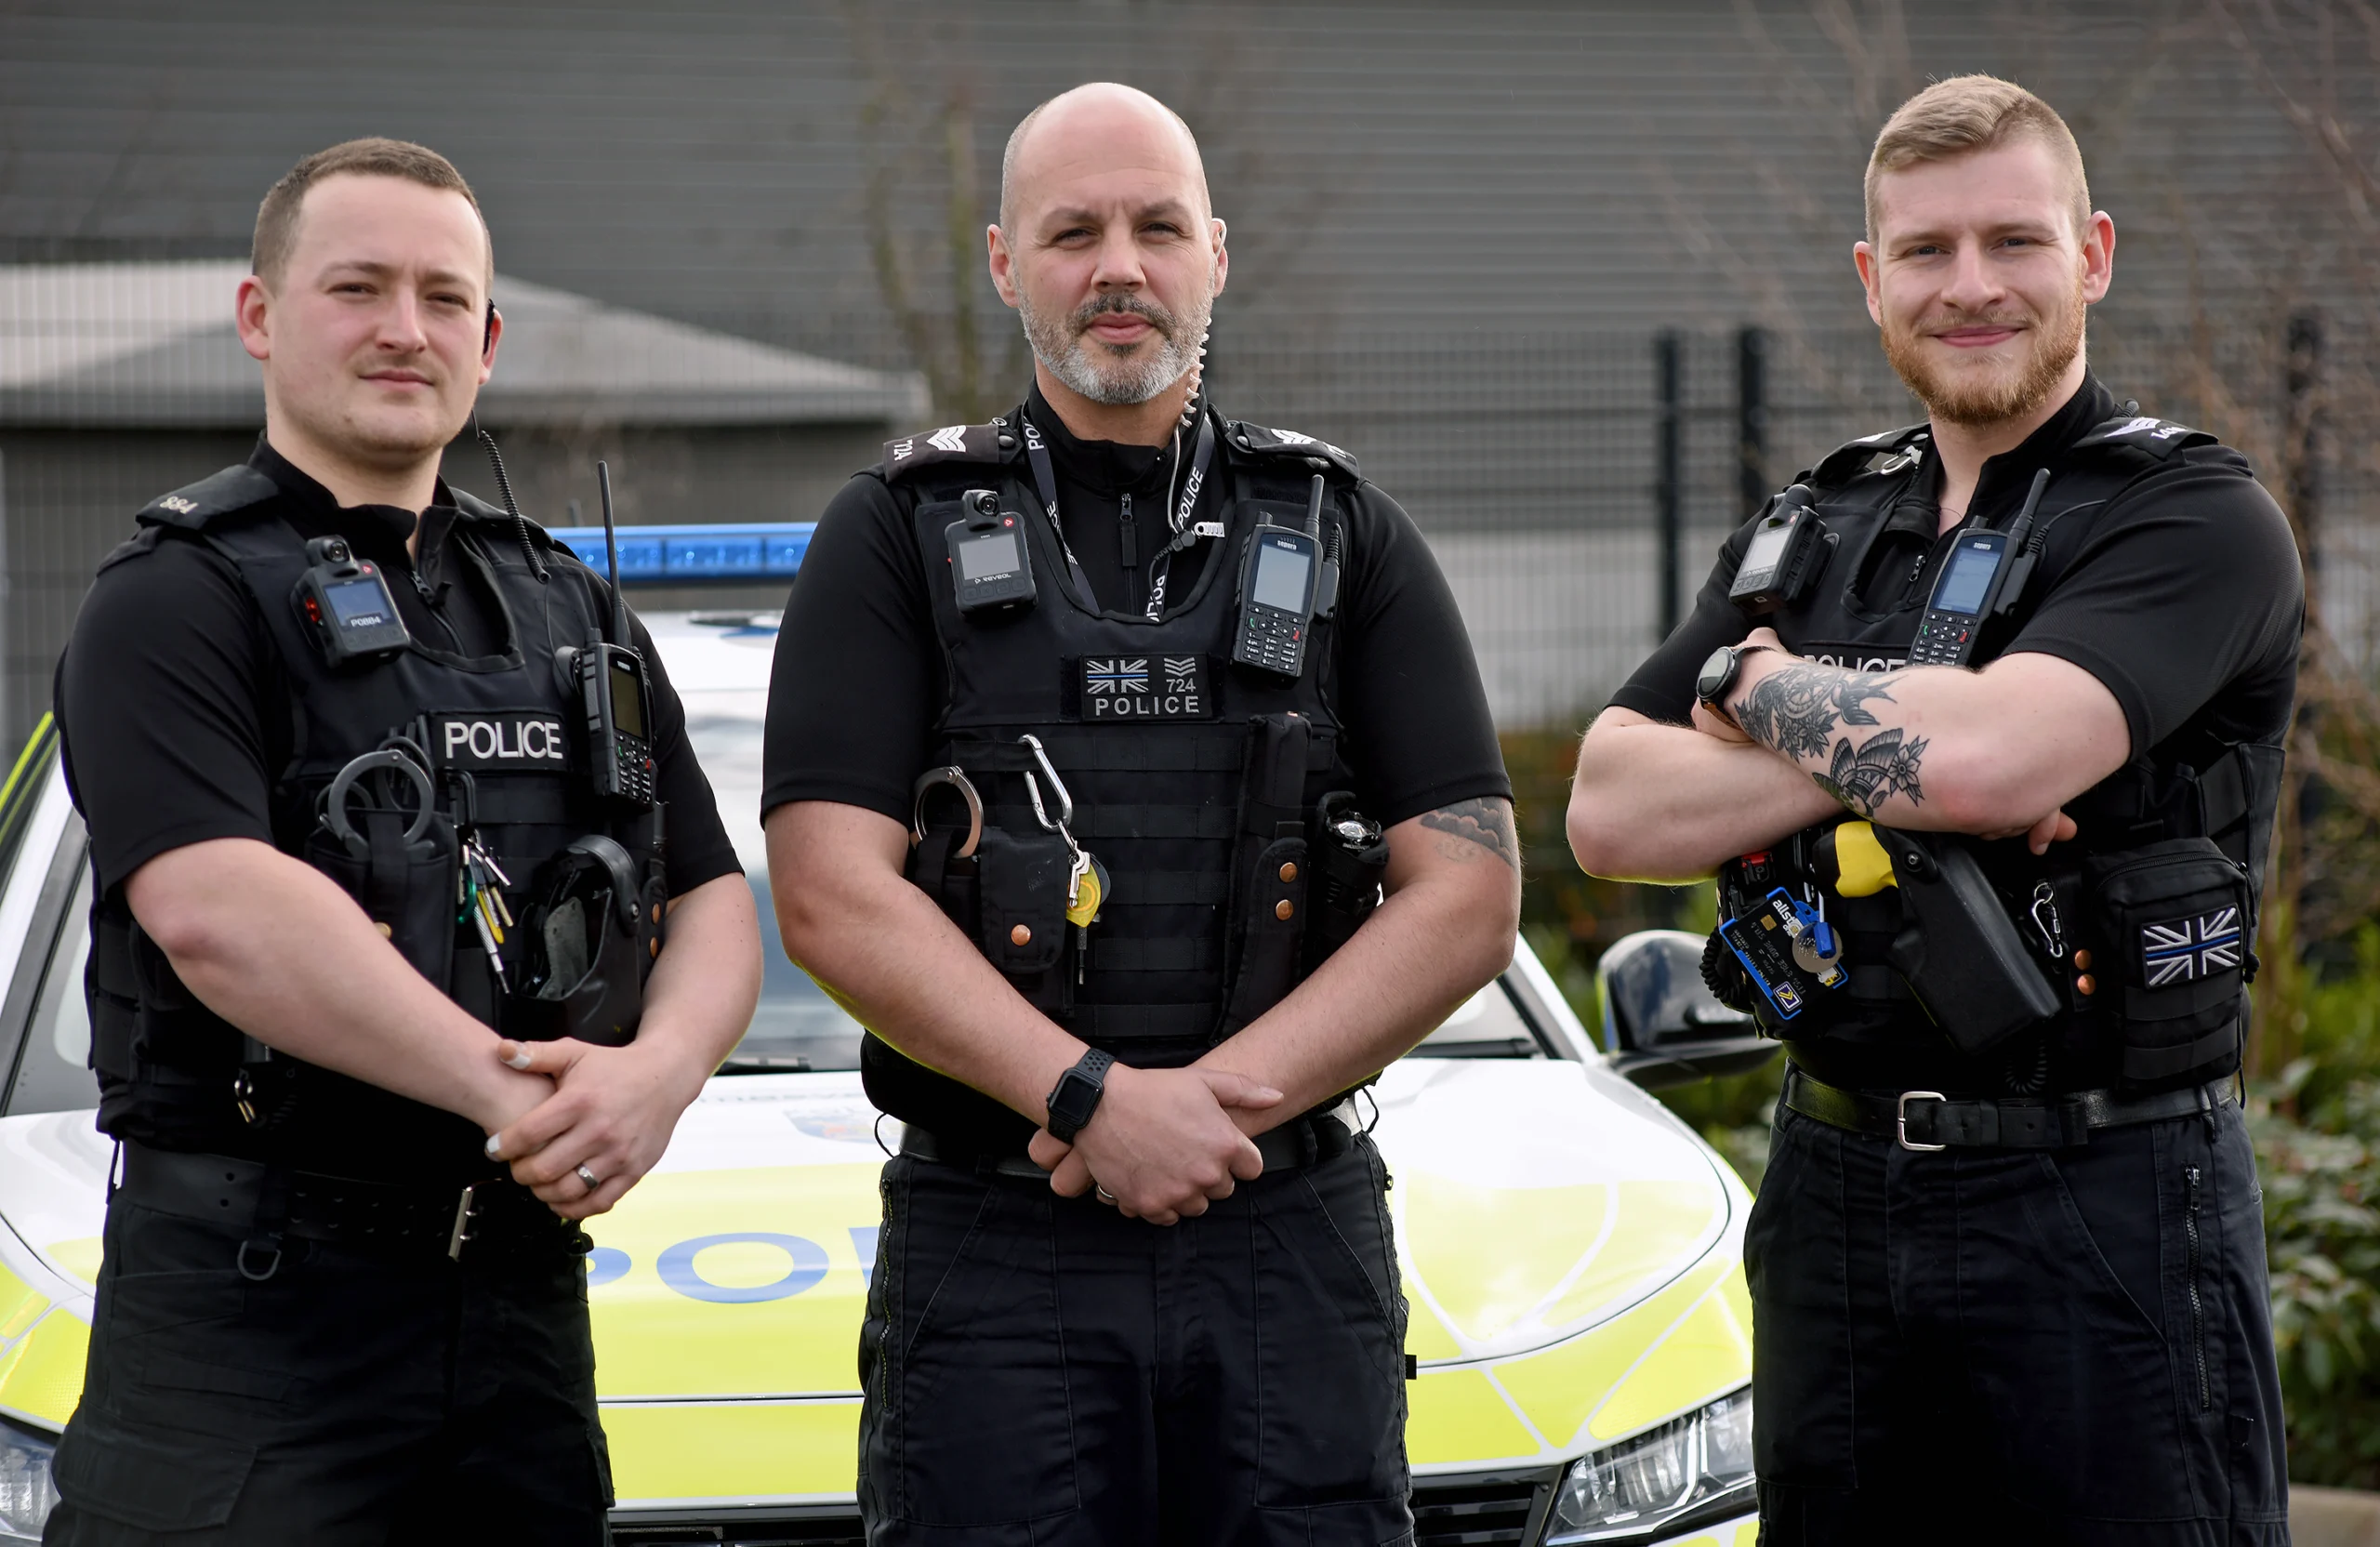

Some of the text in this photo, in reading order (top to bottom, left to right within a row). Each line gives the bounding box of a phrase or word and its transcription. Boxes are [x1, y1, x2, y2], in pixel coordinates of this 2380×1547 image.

[1177, 466, 1204, 530] POLICE
[1166, 677, 1197, 693] 724
[1095, 695, 1199, 716] POLICE
[444, 721, 563, 760] POLICE
